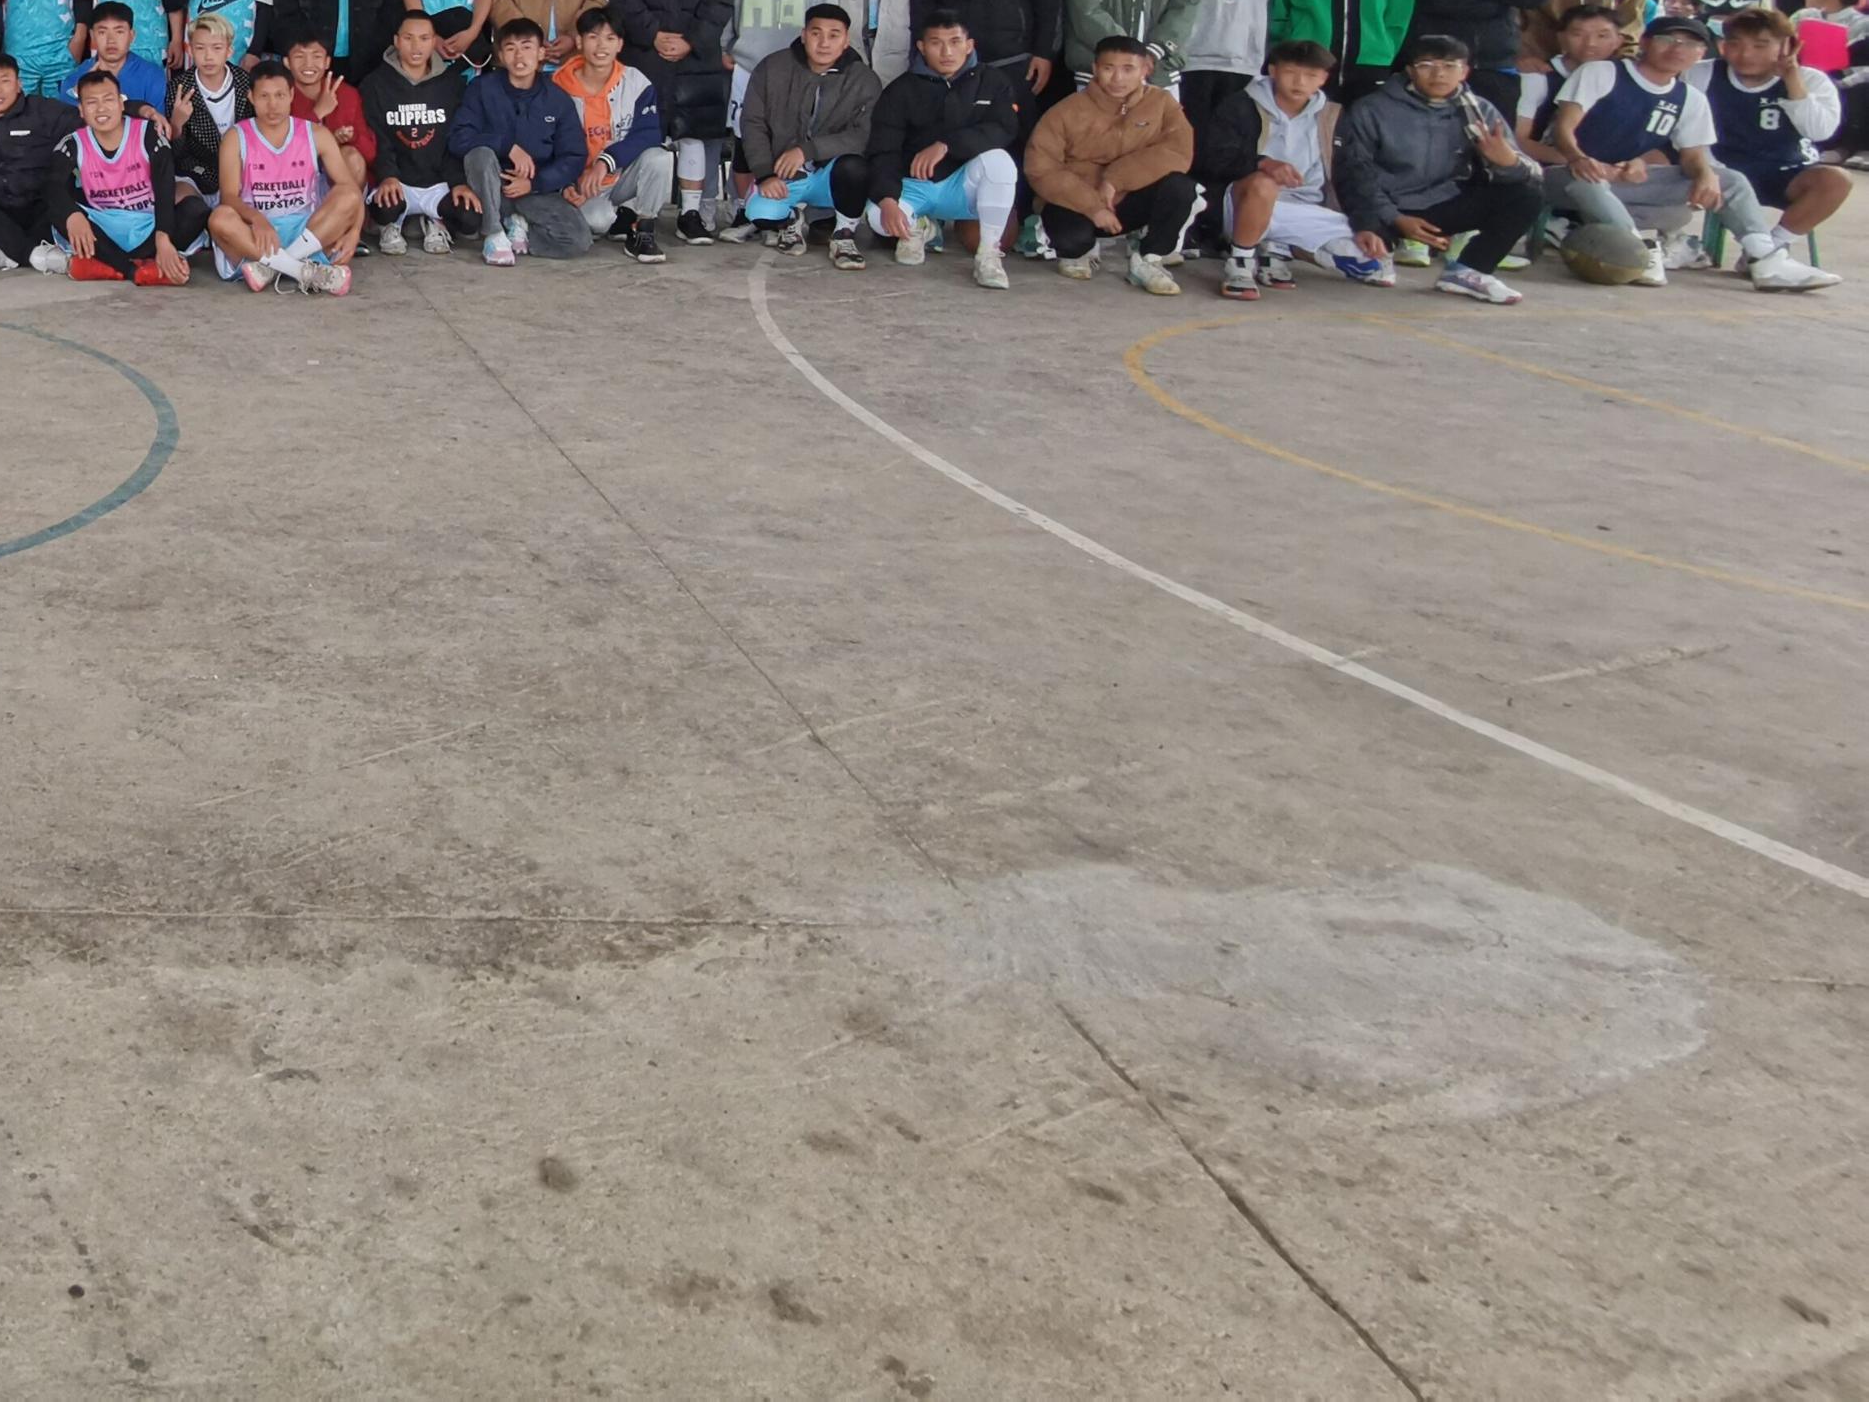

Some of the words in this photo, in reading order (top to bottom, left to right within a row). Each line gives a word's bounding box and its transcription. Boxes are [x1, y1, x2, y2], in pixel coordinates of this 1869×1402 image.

[386, 109, 447, 126] CLIPPERS
[1646, 109, 1676, 136] 10
[1759, 108, 1780, 130] 8
[89, 180, 149, 199] BASKETBALL
[251, 178, 306, 192] ASKETBALL
